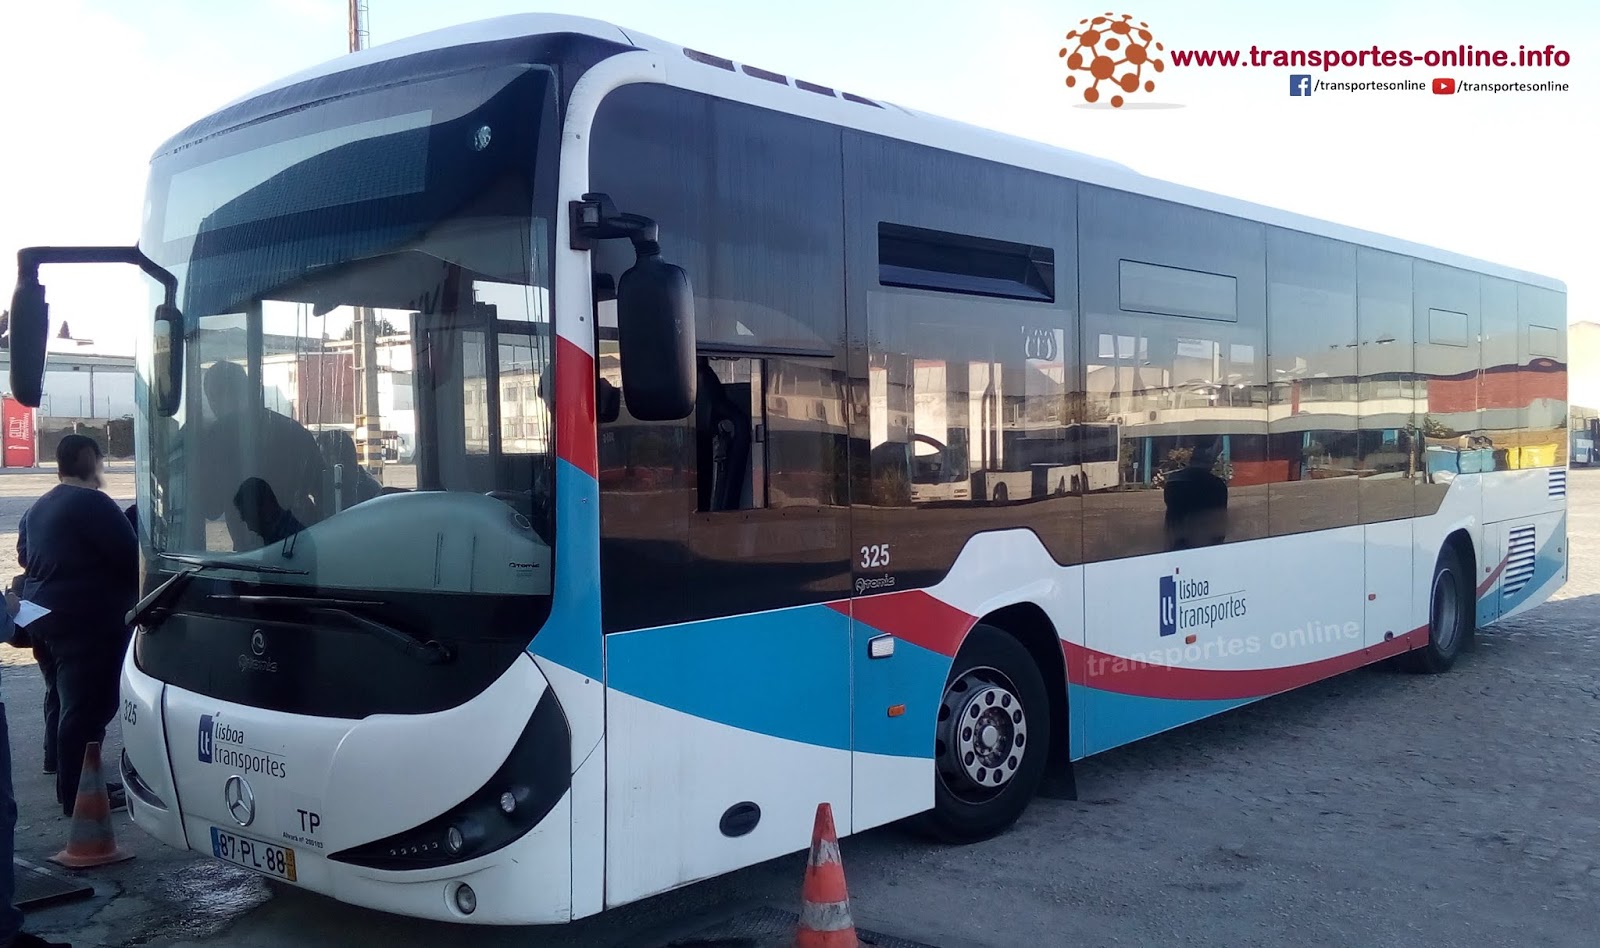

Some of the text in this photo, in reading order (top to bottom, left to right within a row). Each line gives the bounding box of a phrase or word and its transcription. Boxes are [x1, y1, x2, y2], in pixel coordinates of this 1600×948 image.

[860, 543, 890, 568] 325
[1180, 579, 1209, 600] lisboa
[1180, 596, 1246, 629] transportes
[124, 698, 138, 726] 325
[215, 722, 244, 744] lisboa
[215, 743, 286, 778] transportes
[297, 808, 321, 834] TP
